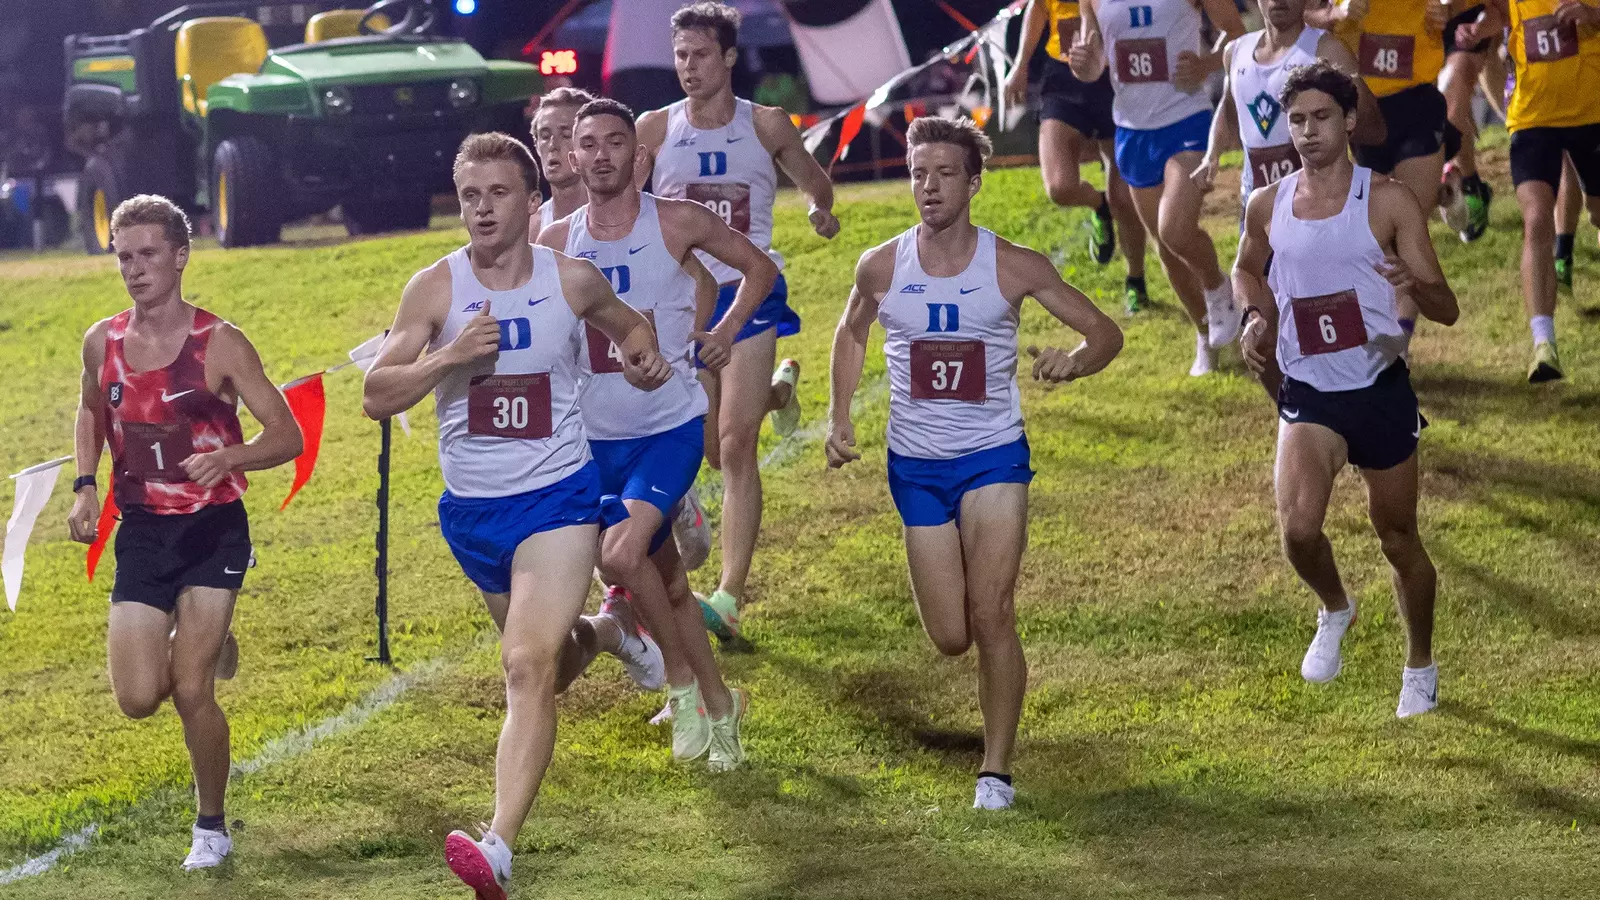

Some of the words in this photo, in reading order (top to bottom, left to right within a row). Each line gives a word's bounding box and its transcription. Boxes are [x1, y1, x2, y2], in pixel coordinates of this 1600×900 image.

[1537, 28, 1561, 56] 51
[1128, 52, 1153, 77] 36
[1373, 48, 1399, 73] 48
[899, 284, 927, 294] ACC
[1318, 314, 1337, 344] 6
[931, 361, 964, 391] 37
[492, 396, 528, 429] 30
[150, 441, 164, 470] 1
